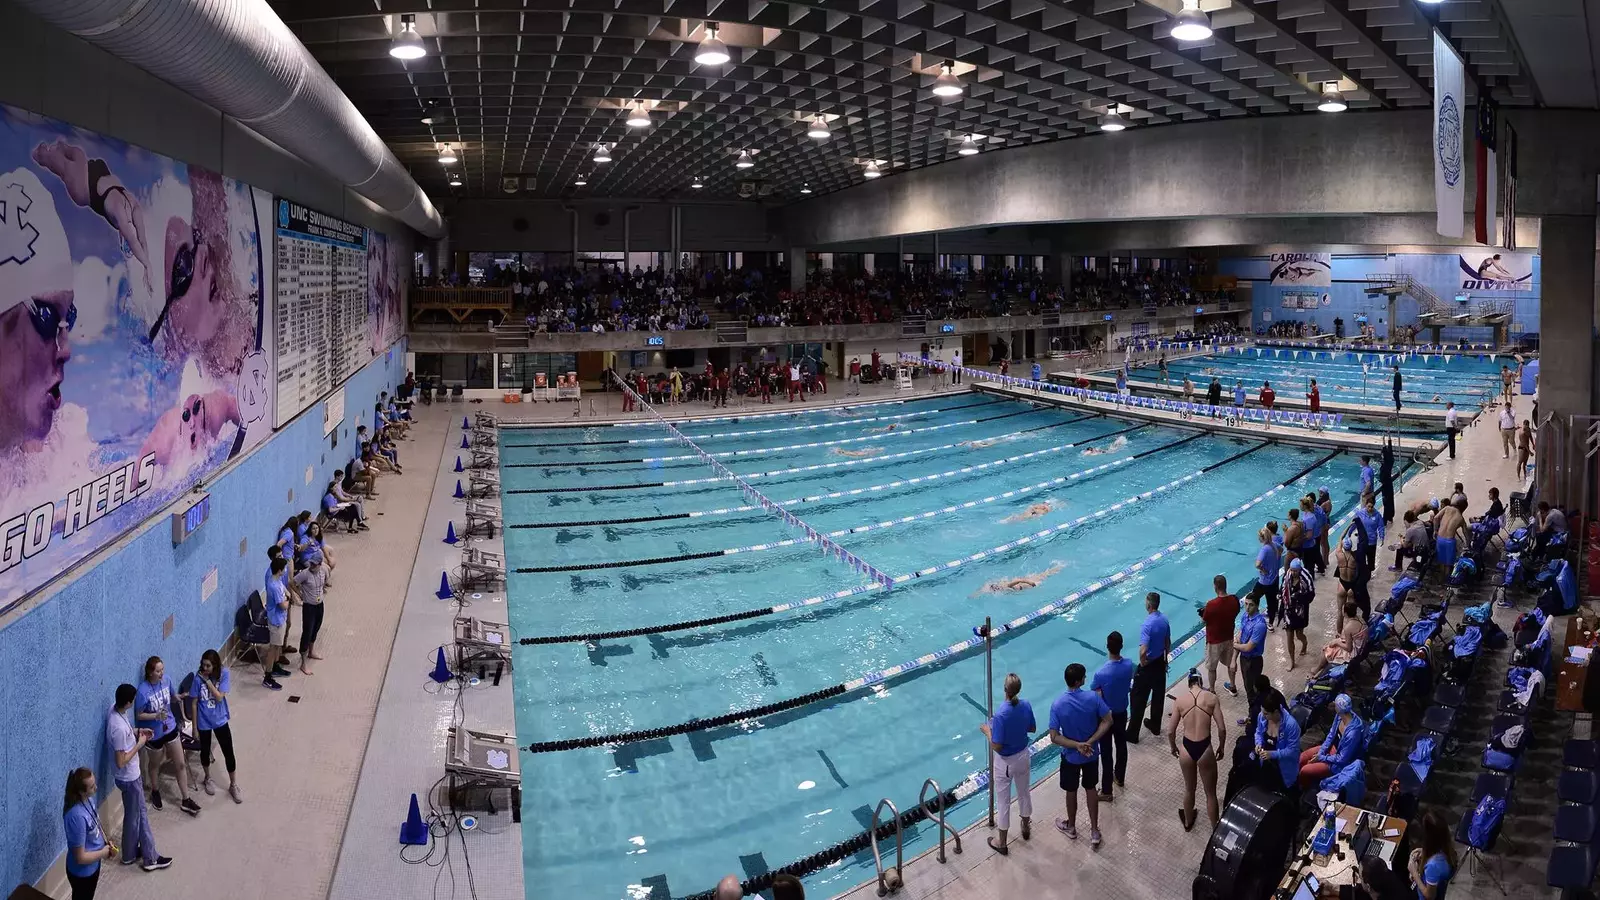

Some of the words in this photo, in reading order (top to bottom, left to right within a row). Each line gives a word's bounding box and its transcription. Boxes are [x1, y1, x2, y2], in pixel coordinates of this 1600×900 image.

[290, 204, 308, 222] UNC
[309, 210, 342, 232] SWIMMING
[1270, 253, 1329, 262] CAROLIN
[1462, 280, 1522, 290] DIVIN
[1225, 417, 1235, 427] 19
[0, 501, 55, 575] GO
[62, 451, 156, 540] HEELS
